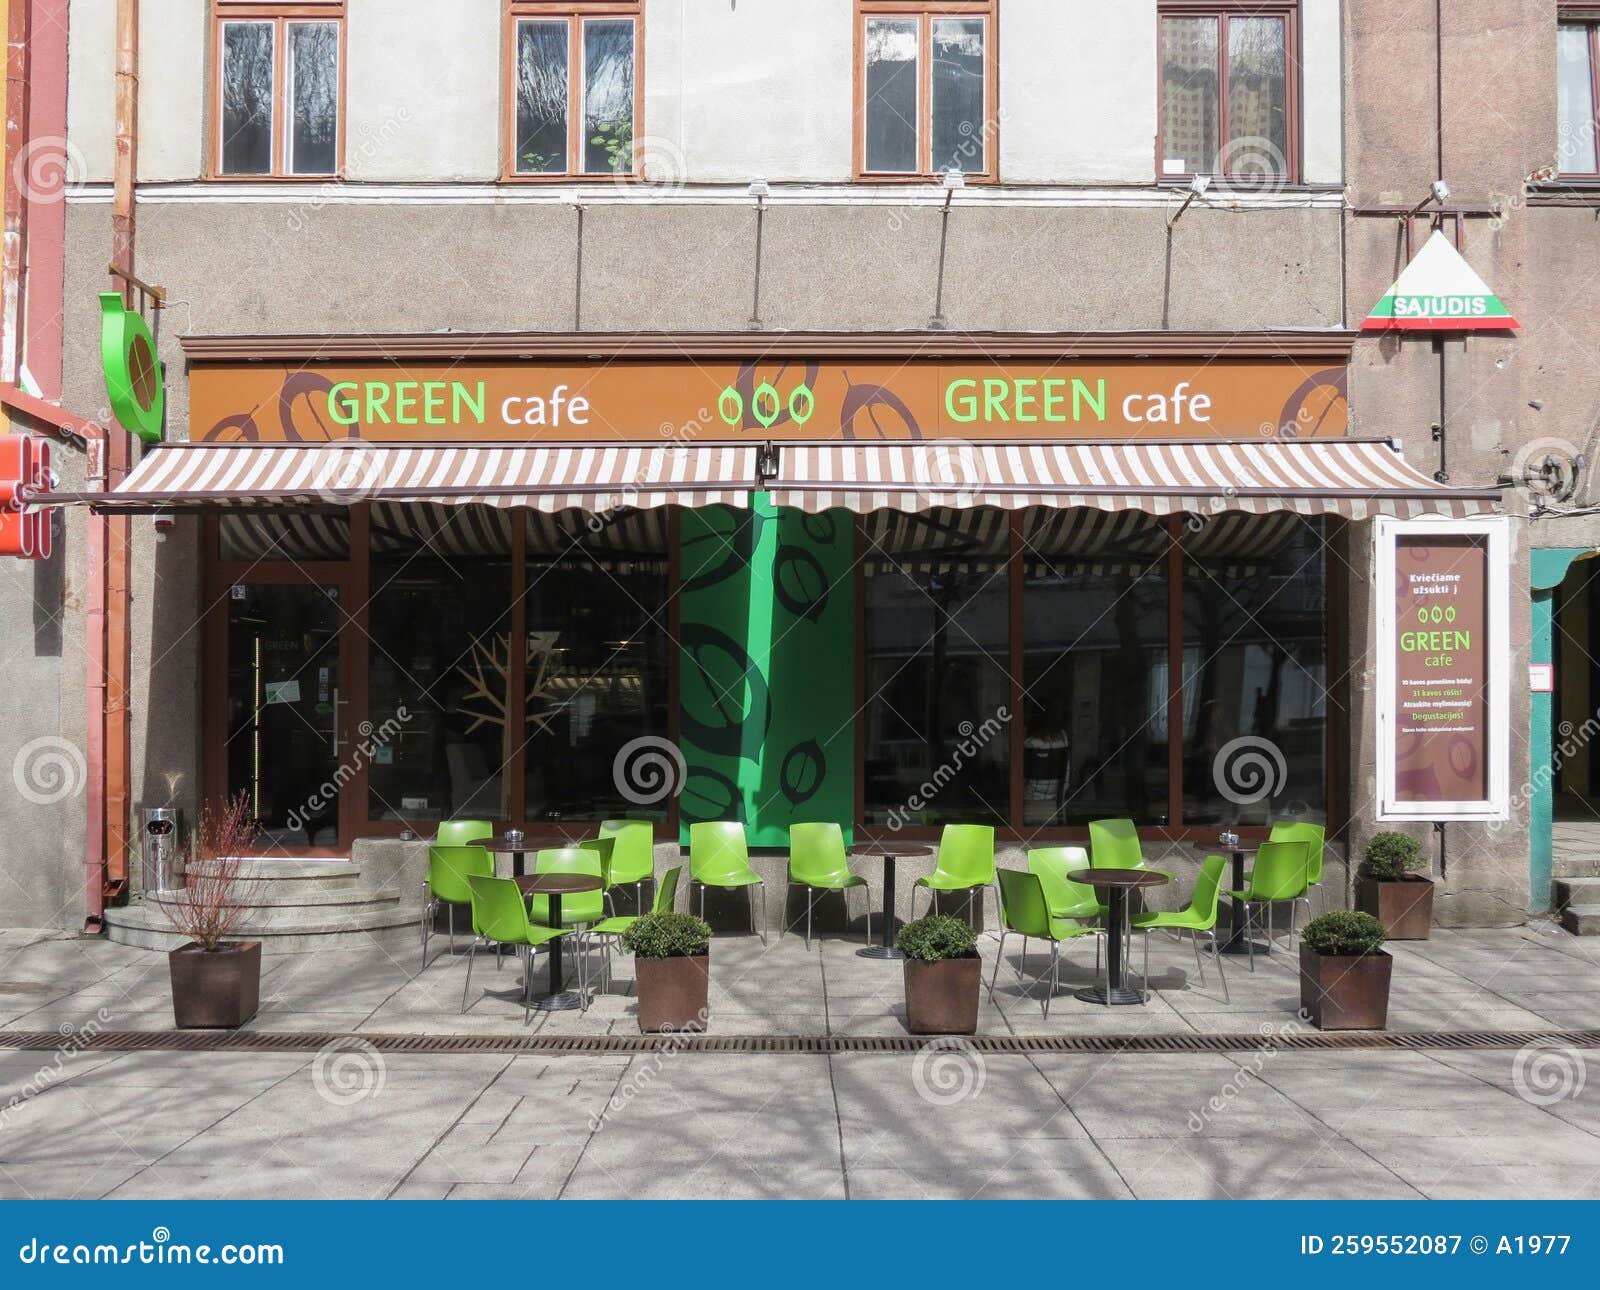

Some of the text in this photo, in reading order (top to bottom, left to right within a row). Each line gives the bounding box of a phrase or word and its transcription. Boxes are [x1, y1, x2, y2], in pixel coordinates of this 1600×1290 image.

[327, 381, 590, 427] GREEN cafe
[945, 378, 1212, 425] GREEN cafe
[1409, 573, 1461, 582] Kviečiame
[1400, 630, 1471, 652] GREEN
[1424, 653, 1453, 667] cafe
